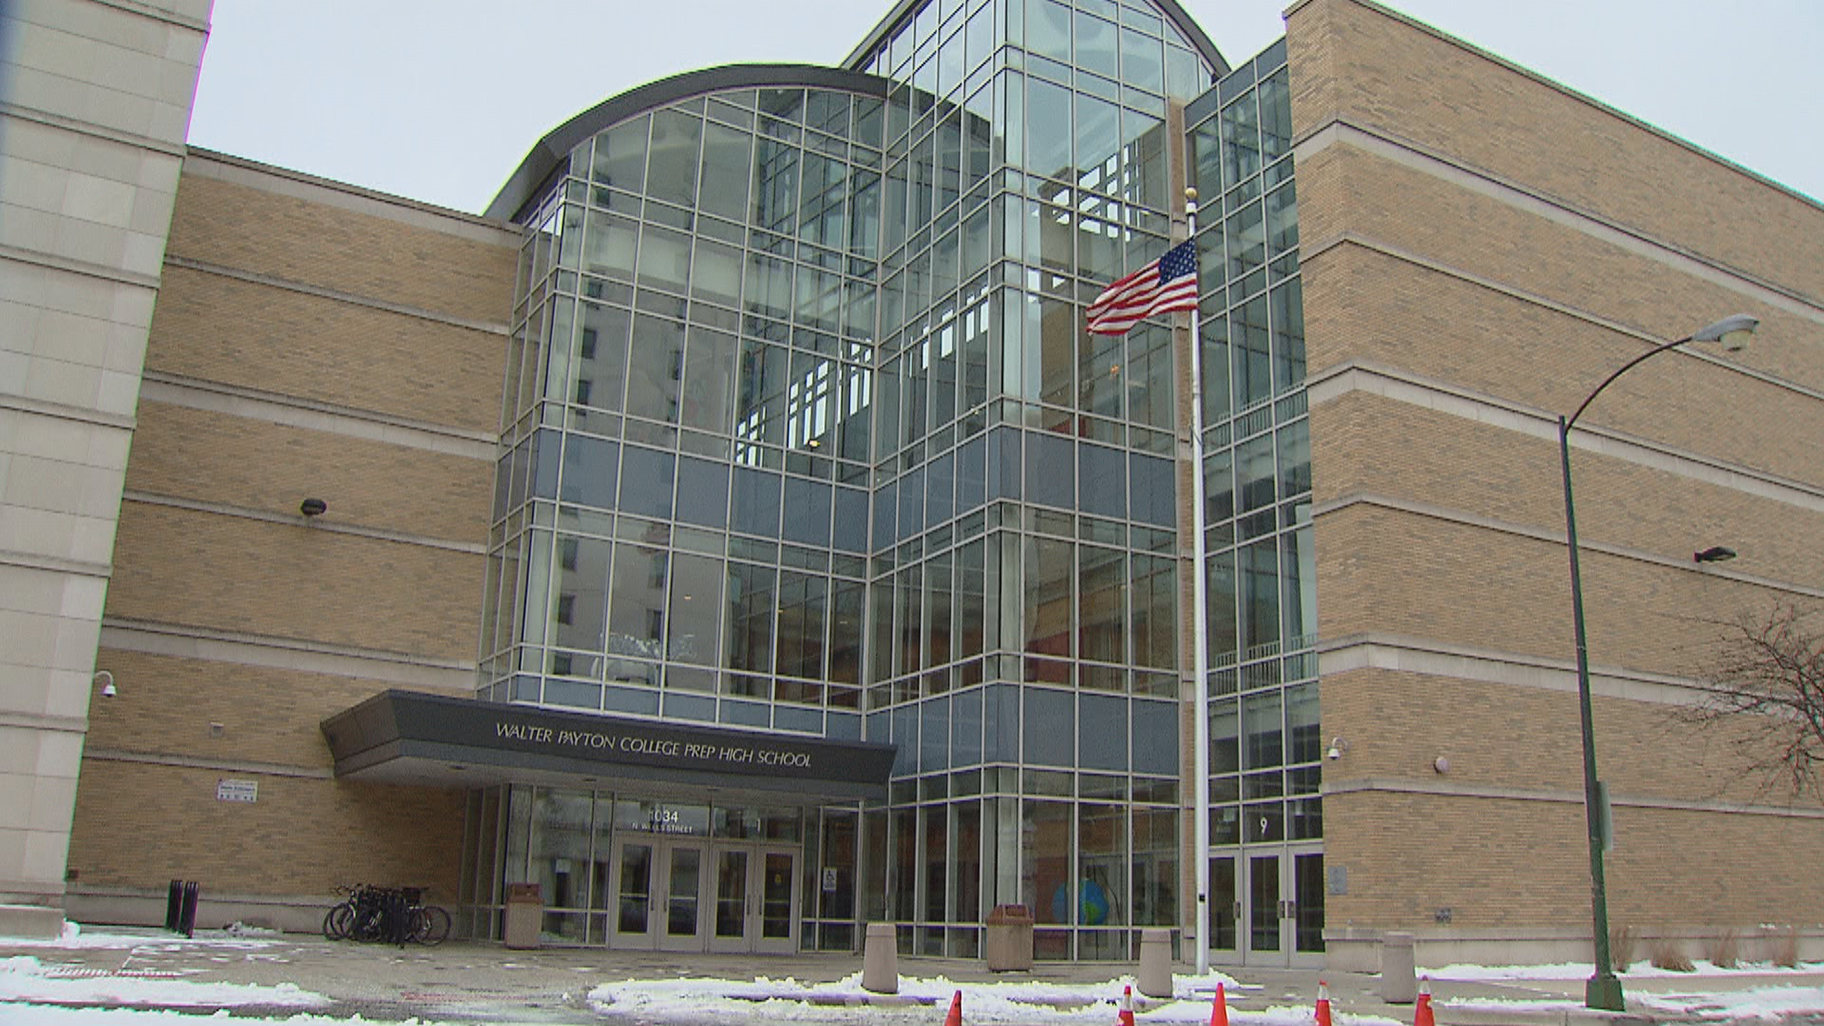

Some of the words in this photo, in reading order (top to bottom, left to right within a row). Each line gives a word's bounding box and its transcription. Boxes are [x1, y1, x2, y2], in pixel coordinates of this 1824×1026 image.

[496, 723, 552, 742] WALTER
[557, 730, 615, 749] PAYTON
[620, 737, 680, 756] COLLEGE
[684, 743, 716, 759] PREP
[719, 747, 753, 763] HIGH
[757, 750, 811, 767] SCHOOL
[648, 809, 679, 823] 1034
[1260, 817, 1268, 834] 9
